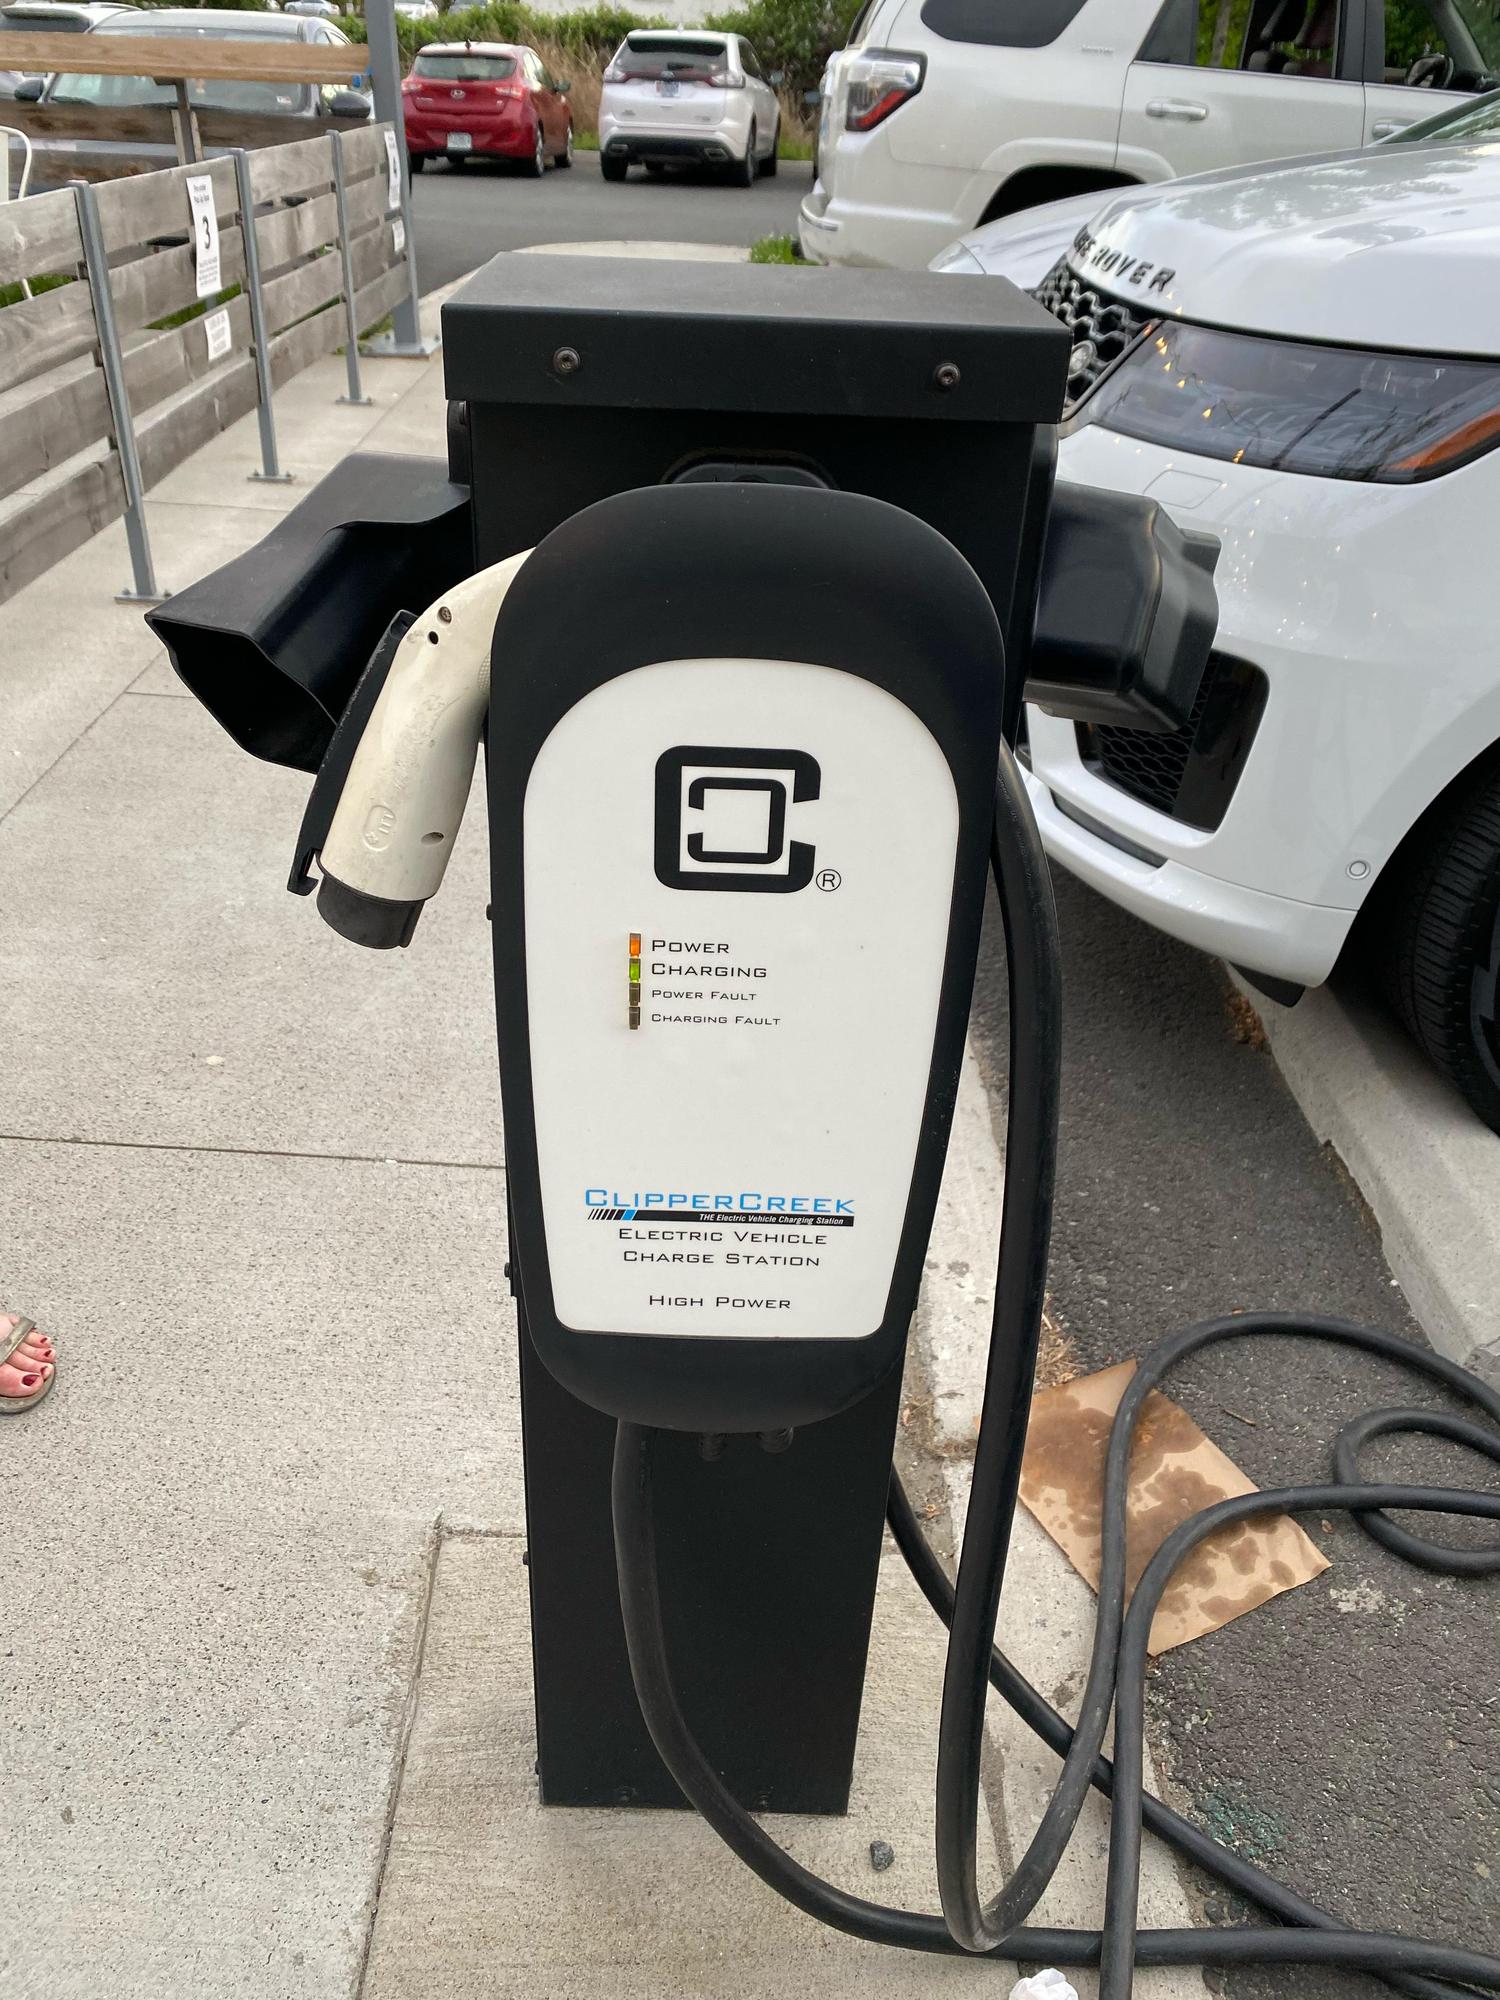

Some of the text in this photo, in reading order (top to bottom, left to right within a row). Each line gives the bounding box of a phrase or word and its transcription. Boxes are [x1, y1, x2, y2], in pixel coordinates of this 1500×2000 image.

[202, 215, 211, 250] 3
[1091, 246, 1177, 293] ROVER
[651, 939, 730, 954] POWER
[651, 962, 768, 978] CHARGING
[651, 989, 758, 1001] POWER FAULT
[651, 1013, 781, 1026] CHARGING FAULT
[699, 1213, 845, 1226] THE Electric Vehicle Charging Station
[618, 1228, 828, 1245] ELECTRIC VEHICLE
[623, 1250, 820, 1267] CHARGE STATION
[649, 1295, 791, 1310] HIGH POWER
